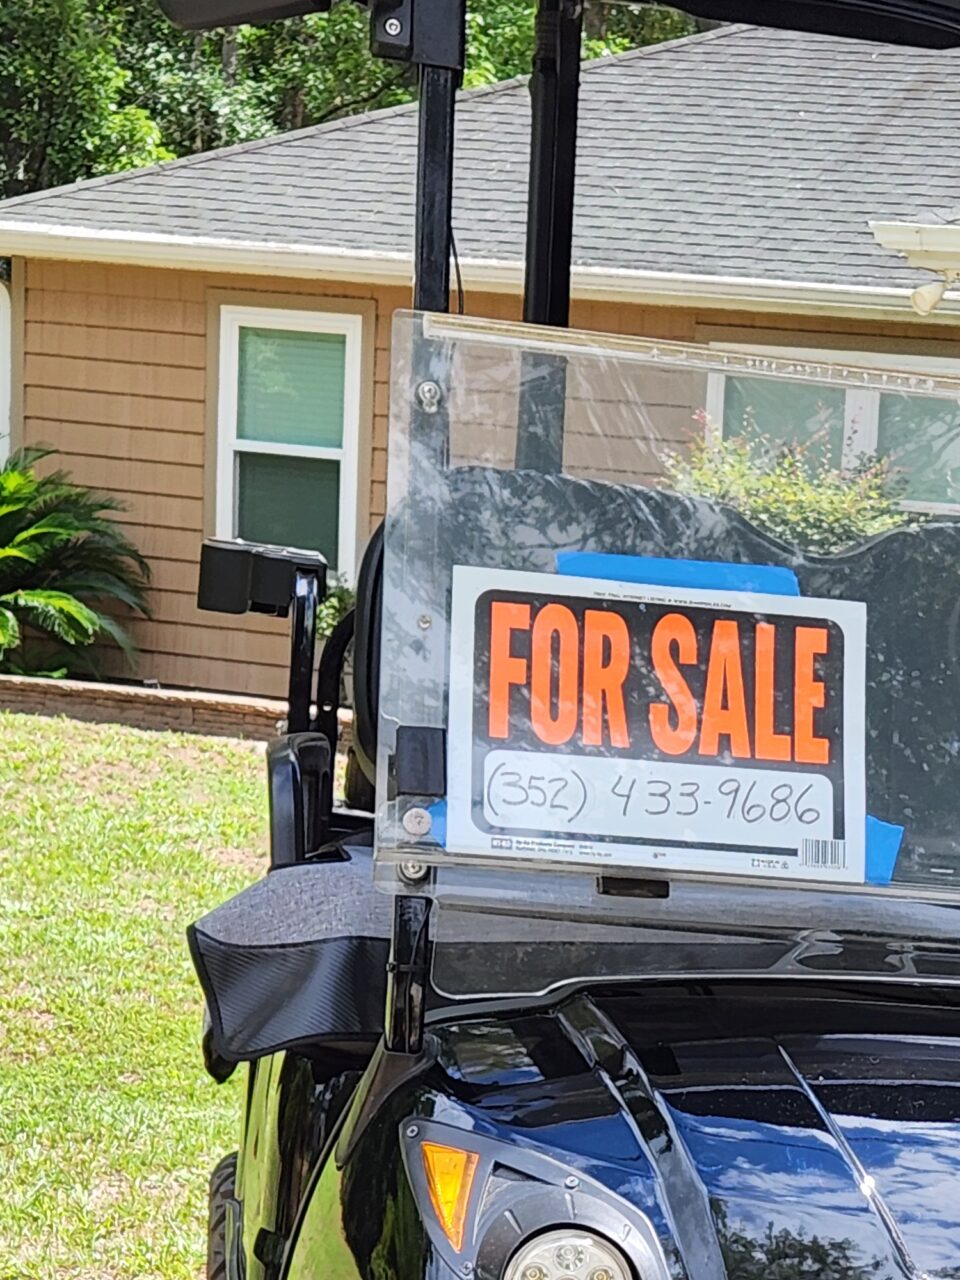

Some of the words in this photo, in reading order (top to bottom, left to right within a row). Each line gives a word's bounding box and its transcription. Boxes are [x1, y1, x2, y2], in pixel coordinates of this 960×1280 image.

[488, 601, 632, 748] FOR
[649, 613, 830, 764] SALE
[487, 762, 588, 823] (352)
[610, 774, 822, 825] 433-9686
